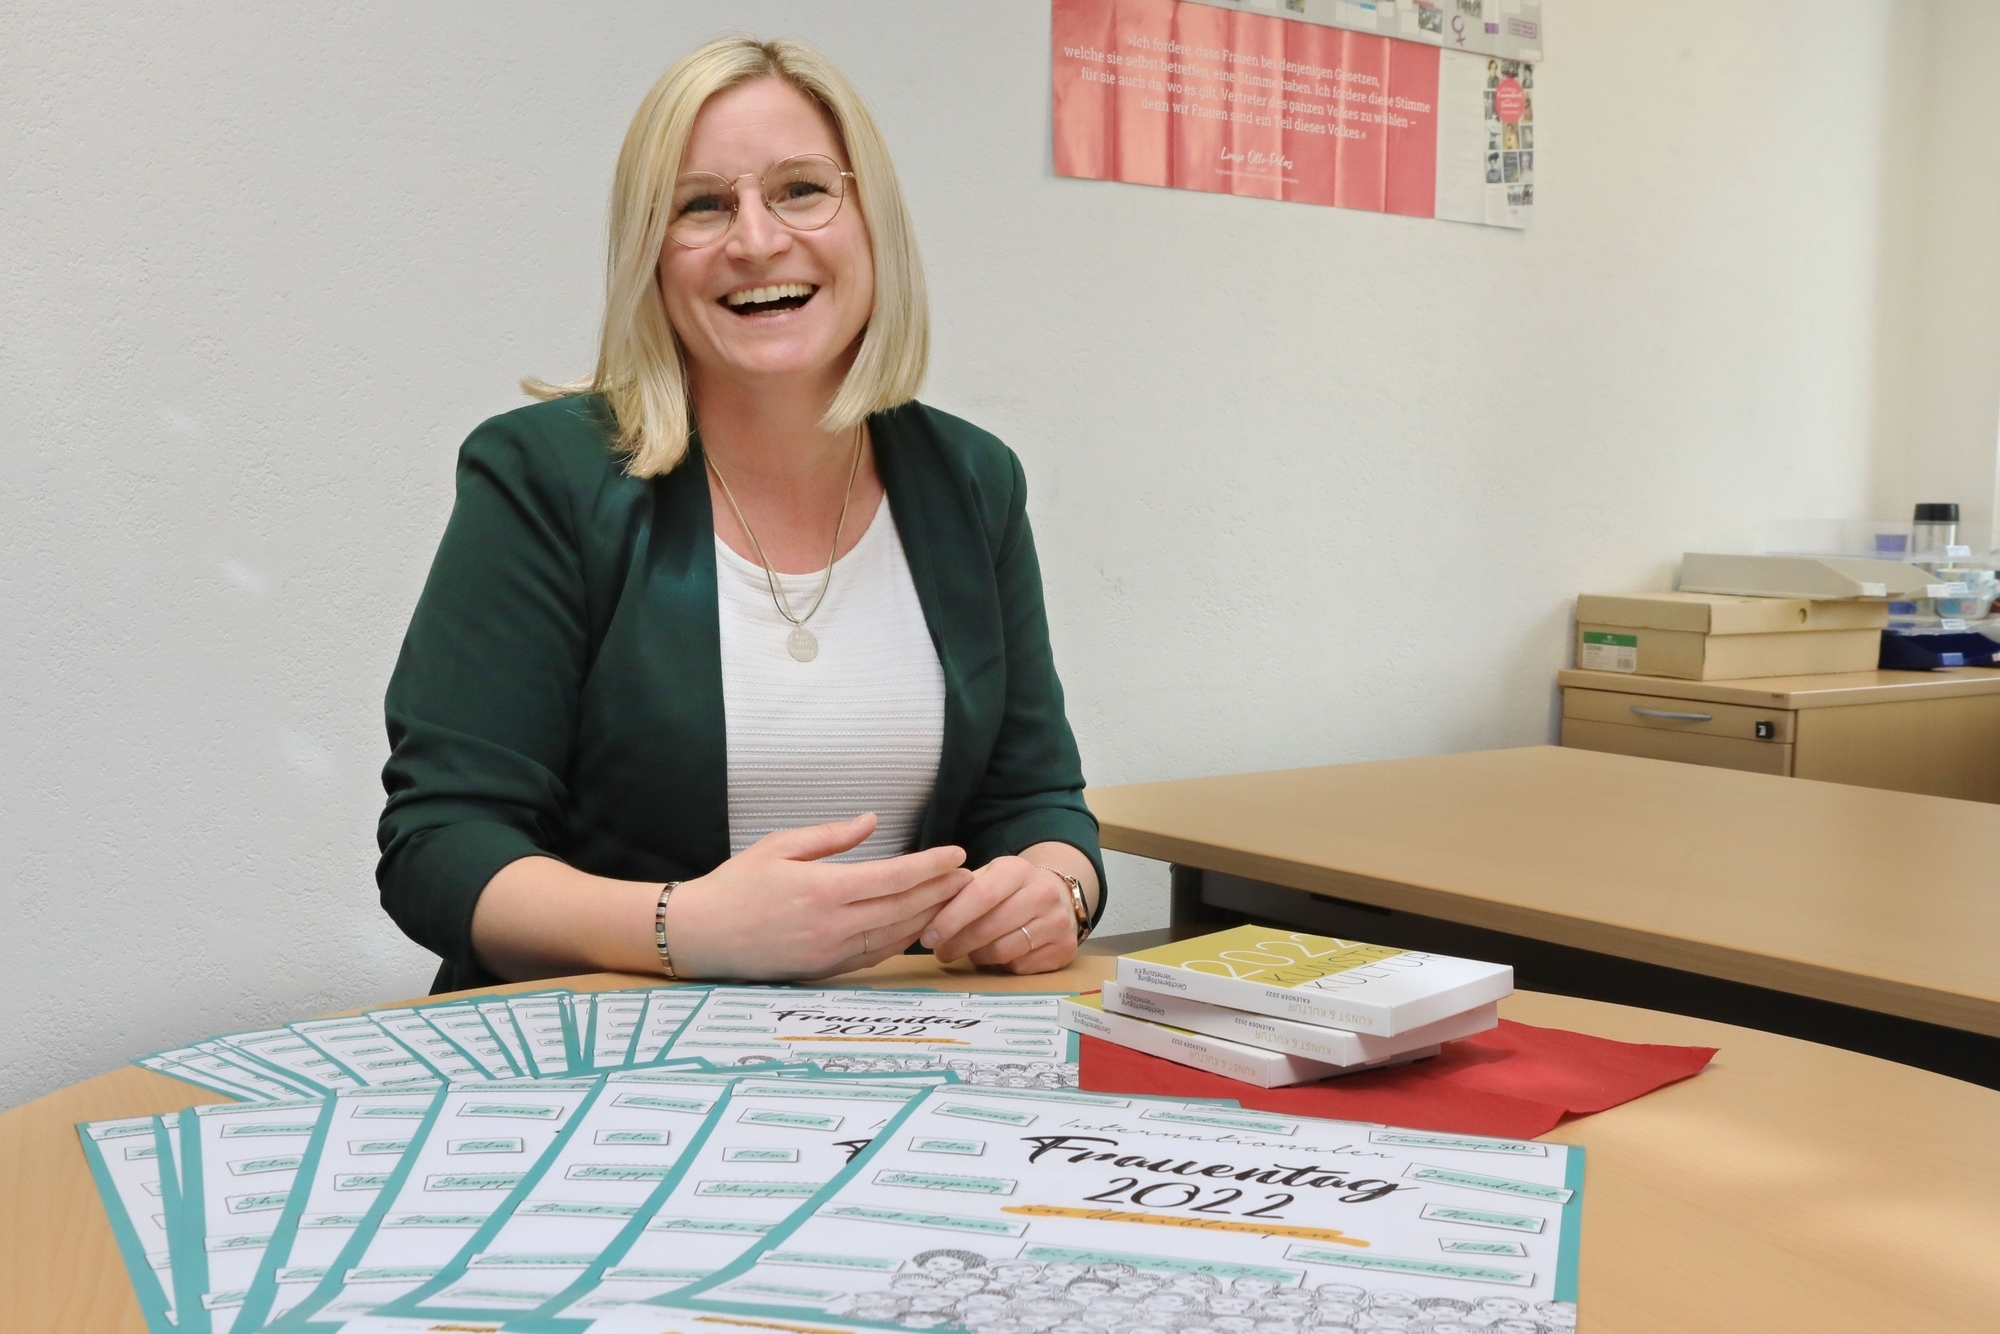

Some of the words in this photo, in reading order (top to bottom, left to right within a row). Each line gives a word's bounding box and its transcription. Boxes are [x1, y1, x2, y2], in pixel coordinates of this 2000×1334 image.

[1153, 38, 1194, 56] fordere,
[1196, 46, 1220, 60] dass
[1222, 49, 1258, 67] Frauen
[1261, 55, 1276, 69] bei
[1279, 59, 1333, 80] denjenigen
[1335, 68, 1380, 88] Gesetzen,
[1064, 46, 1104, 62] welche
[1107, 51, 1123, 64] sie
[1125, 54, 1158, 70] selbst
[1161, 59, 1212, 79] betreffen,
[1213, 67, 1235, 82] eine
[1238, 71, 1278, 89] Stimme
[1281, 78, 1312, 95] haben.
[1315, 83, 1331, 98] Ich
[1332, 86, 1367, 103] fordere
[1368, 92, 1393, 107] diese
[1395, 96, 1431, 113] Stimme
[1081, 66, 1097, 81] für
[1100, 71, 1116, 84] sie
[1118, 74, 1145, 88] auch
[1148, 78, 1164, 92] da,
[1167, 82, 1182, 94] wo
[1185, 85, 1196, 96] es
[1199, 86, 1218, 100] gilt,
[1221, 88, 1266, 107] Vertreter
[1269, 94, 1288, 110] des
[1289, 99, 1324, 115] ganzen
[1327, 104, 1358, 120] Volkes
[1360, 112, 1372, 123] zu
[1374, 112, 1408, 127] wählen
[1141, 97, 1169, 112] denn
[1173, 101, 1189, 115] wir
[1192, 104, 1228, 121] Frauen
[1230, 110, 1253, 124] sind
[1255, 114, 1271, 127] ein
[1274, 116, 1292, 130] Teil
[1294, 119, 1326, 134] dieses
[1181, 933, 1365, 980] 2022
[1142, 967, 1172, 981] Vernetzung
[1263, 951, 1382, 987] KUNST
[1304, 953, 1446, 993] KULTUR
[1137, 974, 1187, 991] Gleichberechtigung
[1281, 993, 1311, 1004] KALENDER
[1288, 1002, 1327, 1018] KULTUR
[1330, 1010, 1336, 1019] &
[769, 1010, 985, 1029] Frauentag
[1235, 1018, 1249, 1026] 2022
[1249, 1020, 1275, 1032] KALENDER
[1339, 1011, 1373, 1027] KUNST
[814, 1024, 927, 1036] 2022
[1254, 1030, 1289, 1046] KULTUR
[1171, 1038, 1183, 1046] 2022
[1183, 1040, 1207, 1053] KALENDER
[1292, 1038, 1298, 1047] &
[1300, 1039, 1331, 1056] KUNST
[1188, 1050, 1219, 1067] KULTUR
[1227, 1060, 1256, 1078] KUNST
[458, 1140, 514, 1152] Film
[606, 1131, 658, 1144] Film
[1059, 1118, 1393, 1158] Internationaler
[1377, 1133, 1490, 1151] Workshop
[733, 1148, 788, 1161] Film
[1020, 1135, 1420, 1204] Frauentag
[881, 1173, 1002, 1194] Shopping
[1415, 1169, 1561, 1198] Gesundheit
[1082, 1177, 1295, 1219] 2022
[1429, 1209, 1528, 1228] Musik
